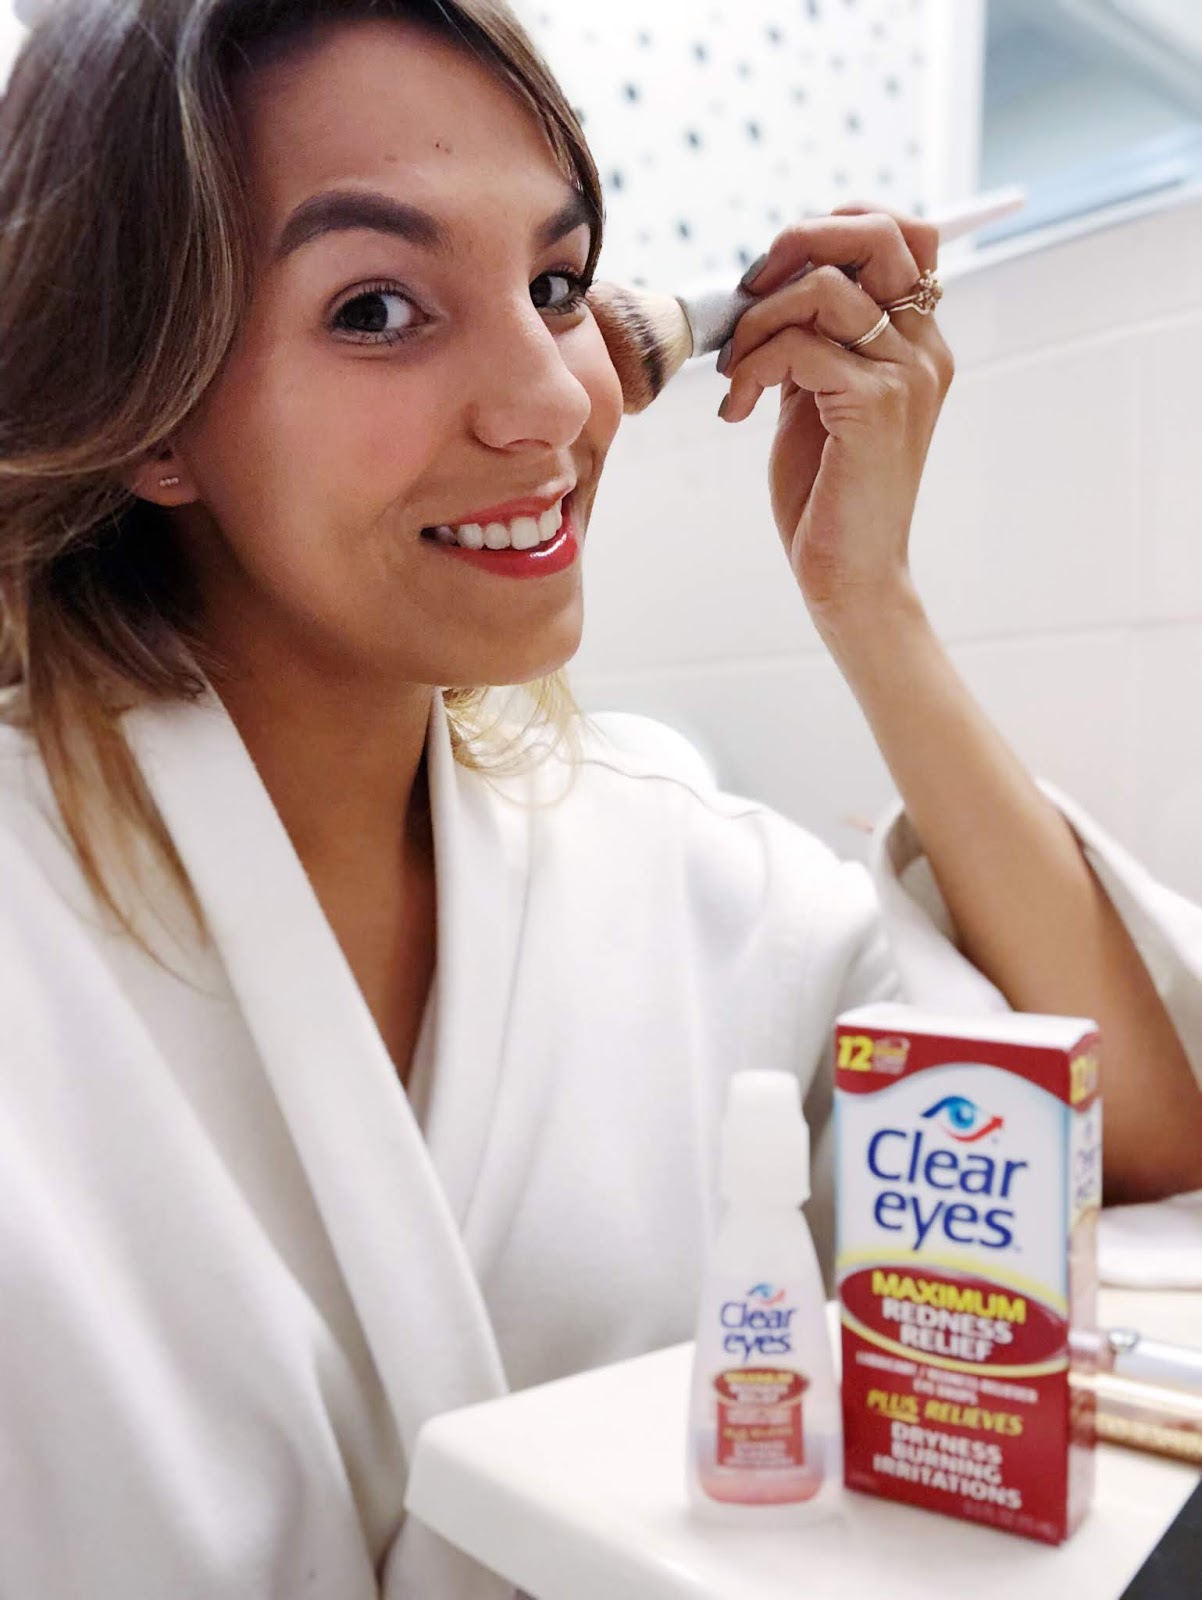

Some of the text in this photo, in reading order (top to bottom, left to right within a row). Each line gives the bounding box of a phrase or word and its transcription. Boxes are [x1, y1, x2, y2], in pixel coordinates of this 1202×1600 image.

[838, 1035, 873, 1071] 12
[867, 1128, 1028, 1198] Clear
[873, 1190, 1015, 1252] eyes
[720, 1302, 797, 1329] Clear
[872, 1270, 1026, 1324] MAXIMUM
[882, 1296, 1013, 1344] REDNESS
[900, 1323, 994, 1361] RELIEF
[723, 1333, 792, 1361] eyes
[891, 1421, 1003, 1466] DRYNESS
[891, 1440, 1002, 1485] BURNING
[872, 1453, 1022, 1509] IRRITATIONS
